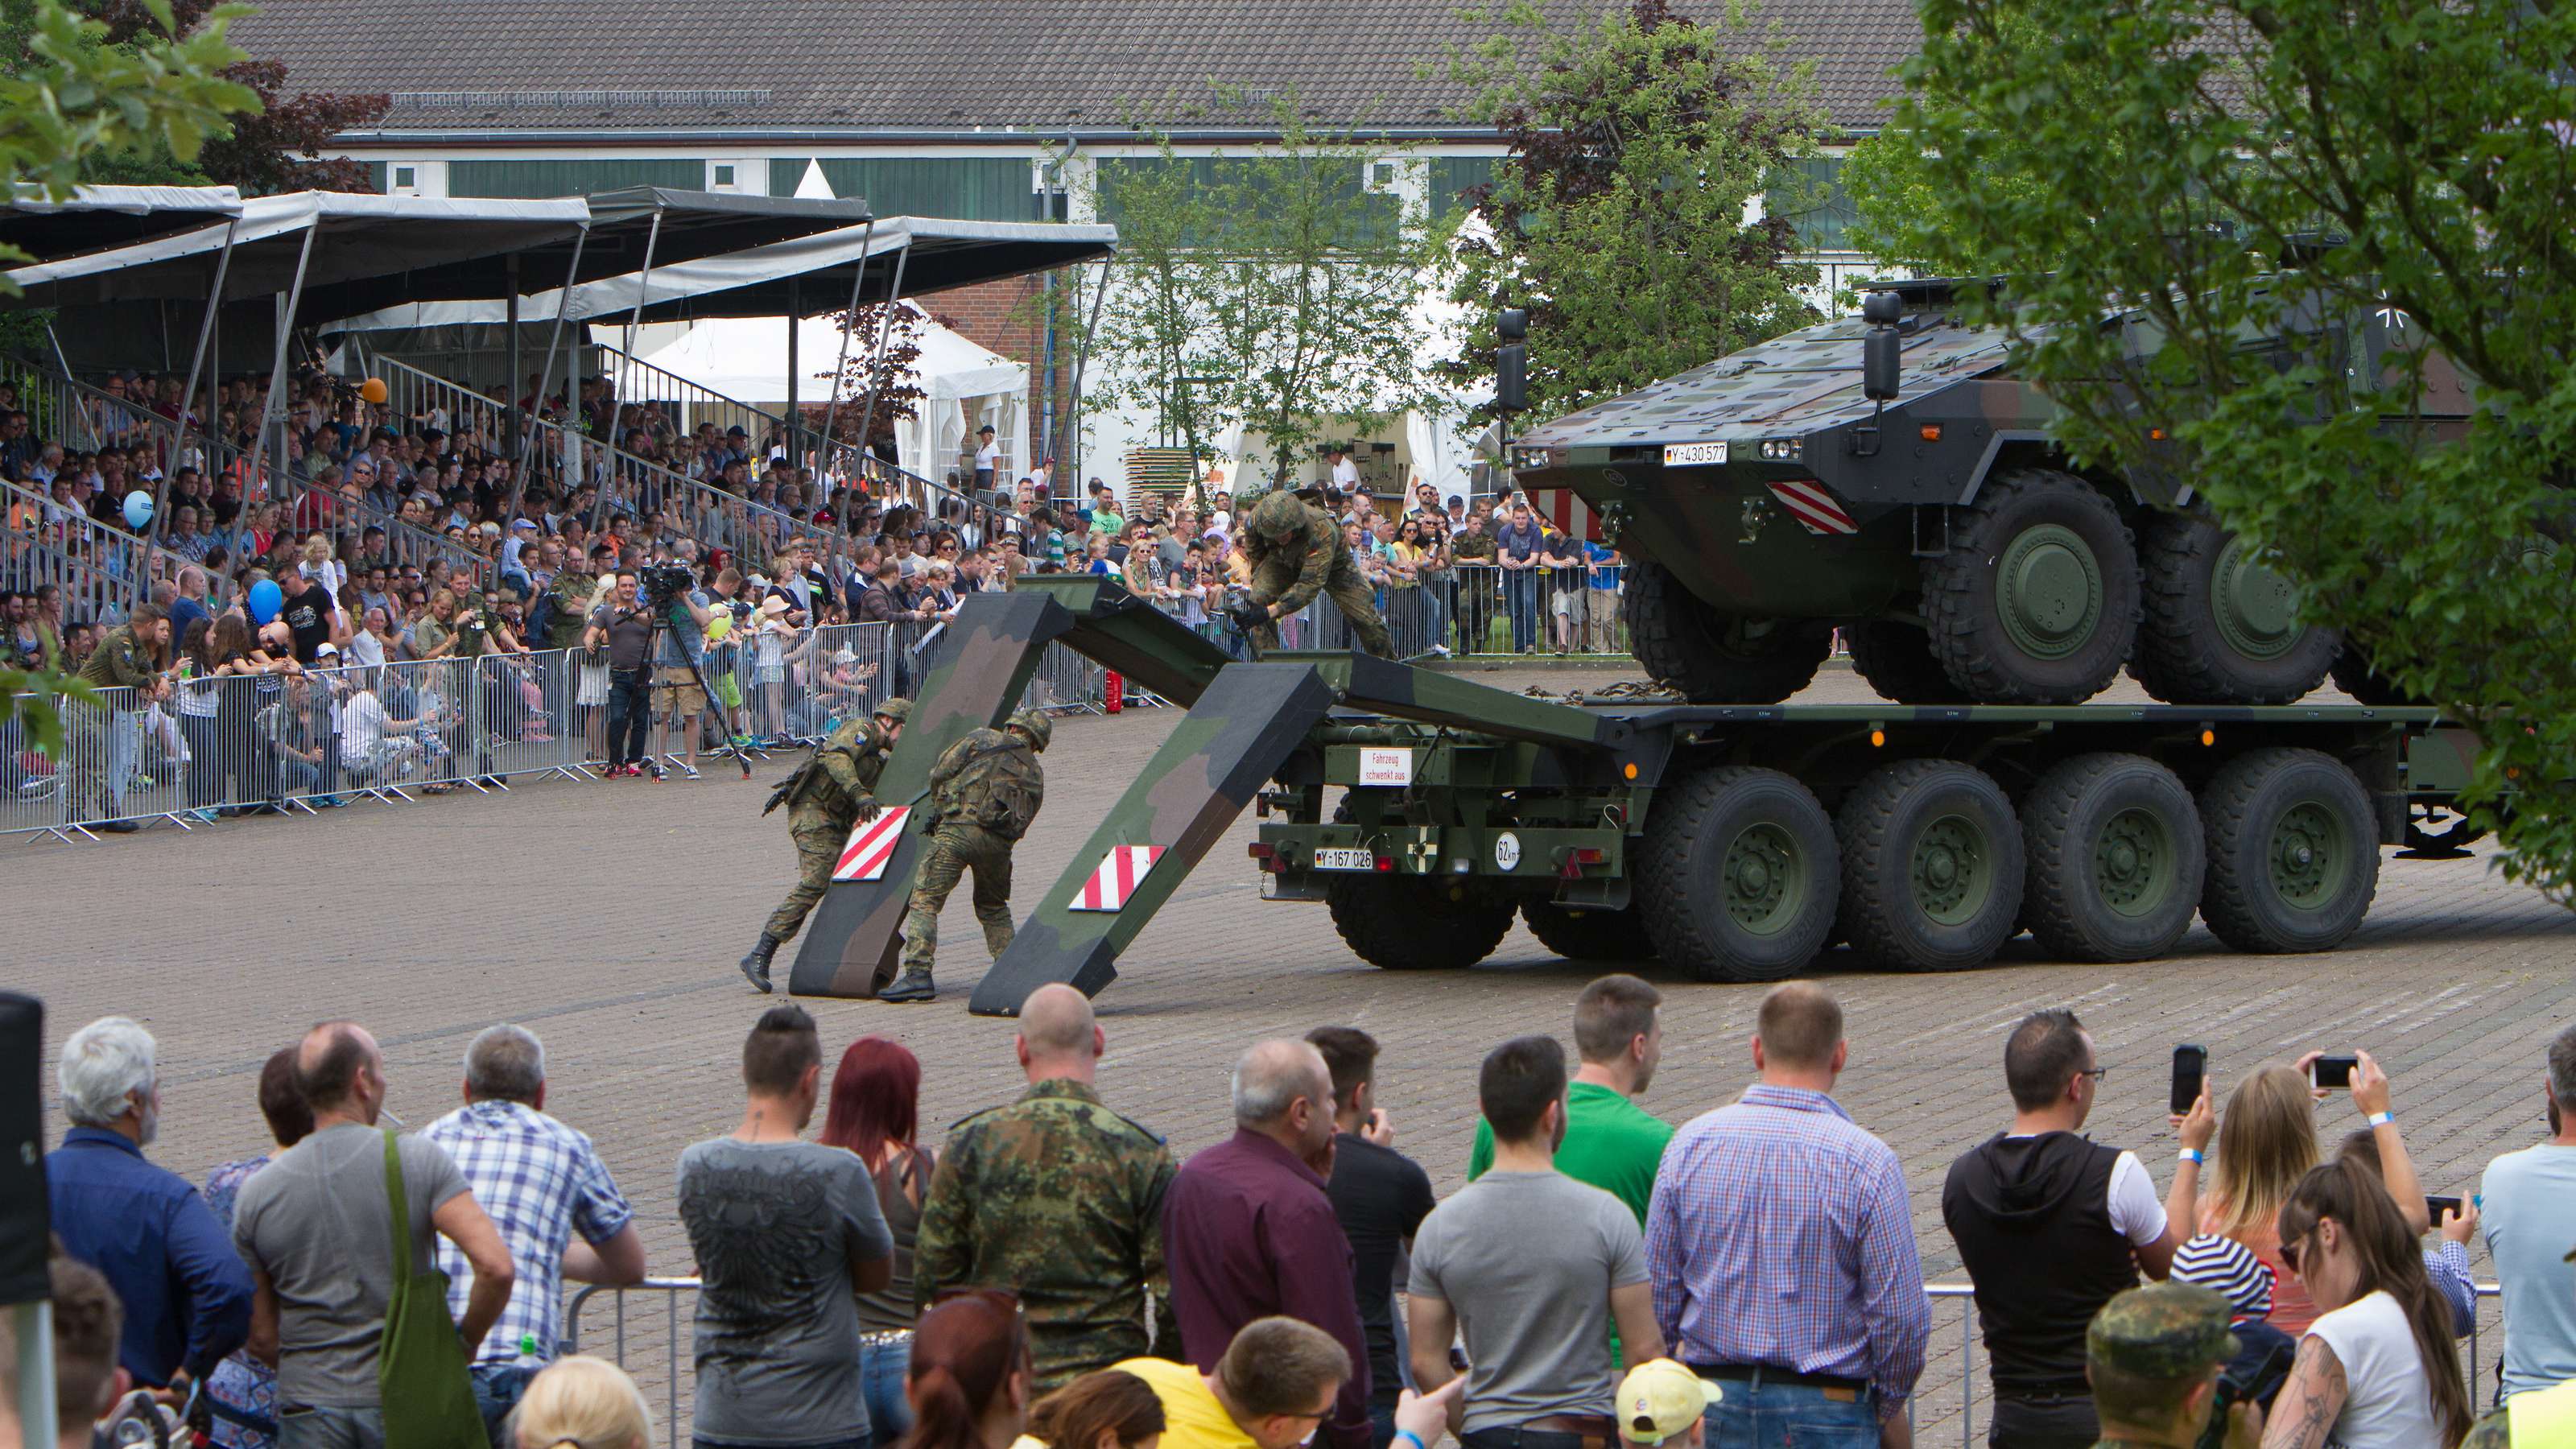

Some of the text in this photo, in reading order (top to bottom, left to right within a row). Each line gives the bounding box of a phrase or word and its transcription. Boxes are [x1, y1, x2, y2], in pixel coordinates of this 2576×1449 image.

[1707, 445, 1725, 461] 577
[1373, 753, 1399, 767] Fahrzeug
[1365, 769, 1406, 780] schwenkt aus
[1353, 851, 1371, 868] 026
